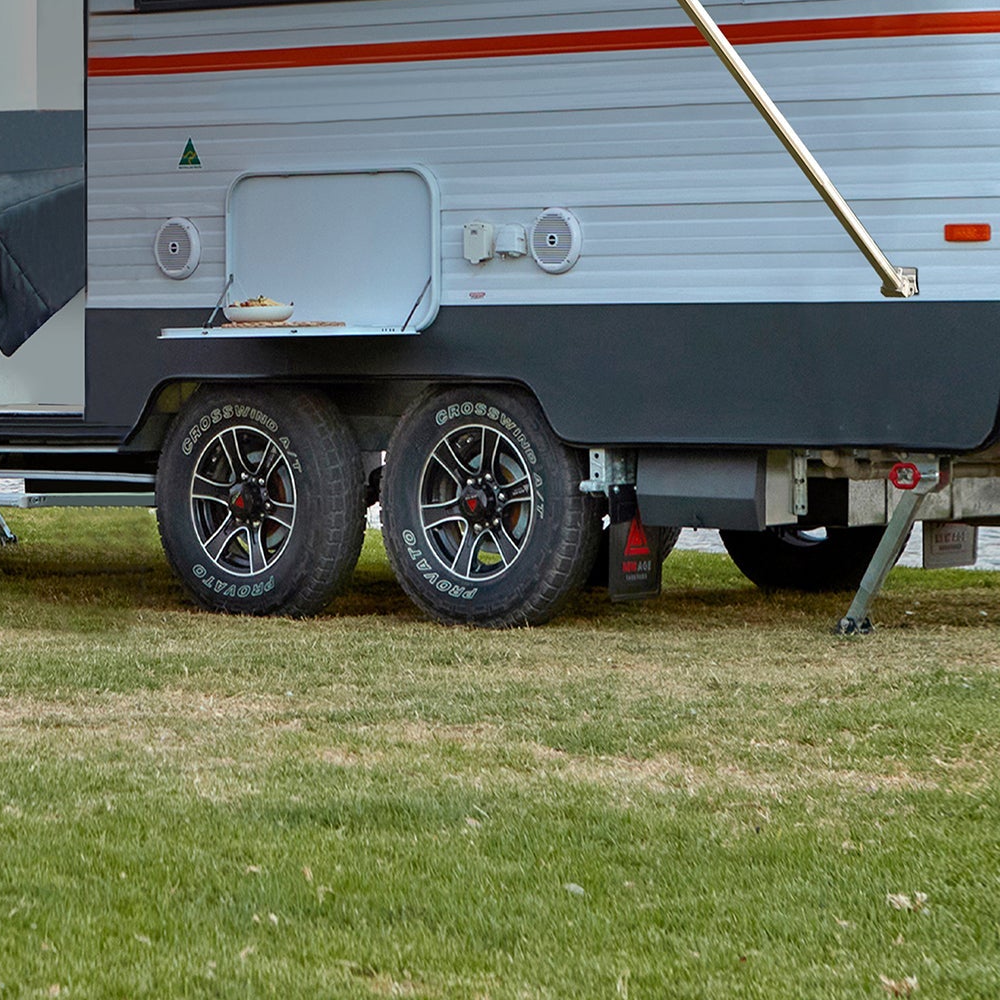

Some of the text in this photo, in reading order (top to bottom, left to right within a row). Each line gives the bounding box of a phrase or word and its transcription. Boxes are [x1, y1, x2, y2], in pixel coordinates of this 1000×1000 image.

[182, 404, 302, 473] CROSSWIND A/T
[435, 401, 545, 519] CROSSWIND A/T
[192, 564, 275, 597] PROVATO
[402, 529, 478, 599] PROVATO
